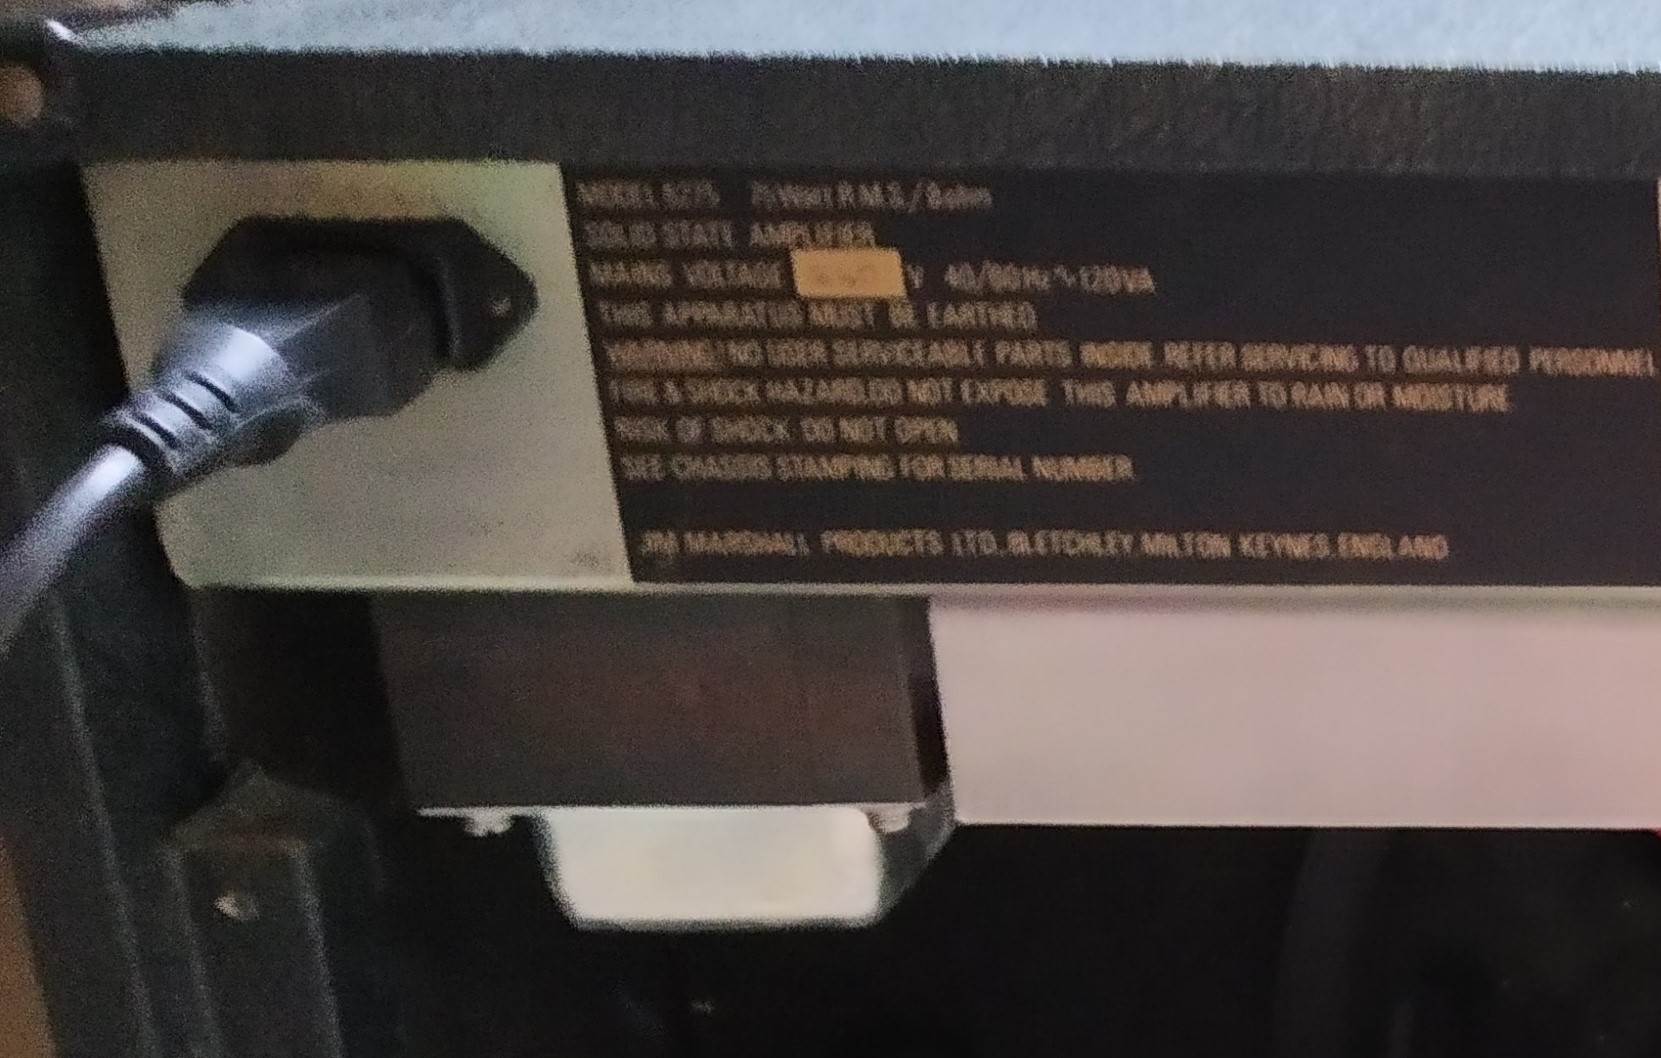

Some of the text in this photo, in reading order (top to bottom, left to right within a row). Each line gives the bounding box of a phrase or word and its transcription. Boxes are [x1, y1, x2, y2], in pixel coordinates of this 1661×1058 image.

[682, 260, 784, 288] VOLTAGE
[600, 302, 654, 329] THIS
[808, 302, 876, 329] MUST
[889, 303, 919, 330] BE
[927, 302, 1037, 330] EARTHED
[995, 340, 1072, 369] PARTS
[1163, 341, 1237, 371] REFER
[1240, 342, 1359, 373] SERVICING
[1365, 344, 1396, 373] TO
[1401, 344, 1520, 375] QUALIFIED
[1529, 346, 1655, 378] PERSONNEL
[907, 378, 954, 406] NOT
[961, 379, 1047, 407] EXPOSE
[1062, 379, 1117, 407] THIS
[1126, 380, 1251, 409] AMPLIFIER
[1257, 382, 1287, 409] TO
[1290, 382, 1350, 411] RAIN
[1353, 382, 1387, 411] OR
[1393, 382, 1510, 413] MOISTURE
[838, 416, 887, 444] NOT
[894, 417, 959, 445] OPEN
[670, 453, 772, 481] CHASSIS
[775, 453, 894, 481] STAMPING
[900, 454, 945, 481] FOR
[948, 454, 1025, 481] SERIAL
[1031, 454, 1135, 482] NUMBER
[683, 529, 810, 556] MARSHALL
[820, 529, 944, 556] PRODUCTS
